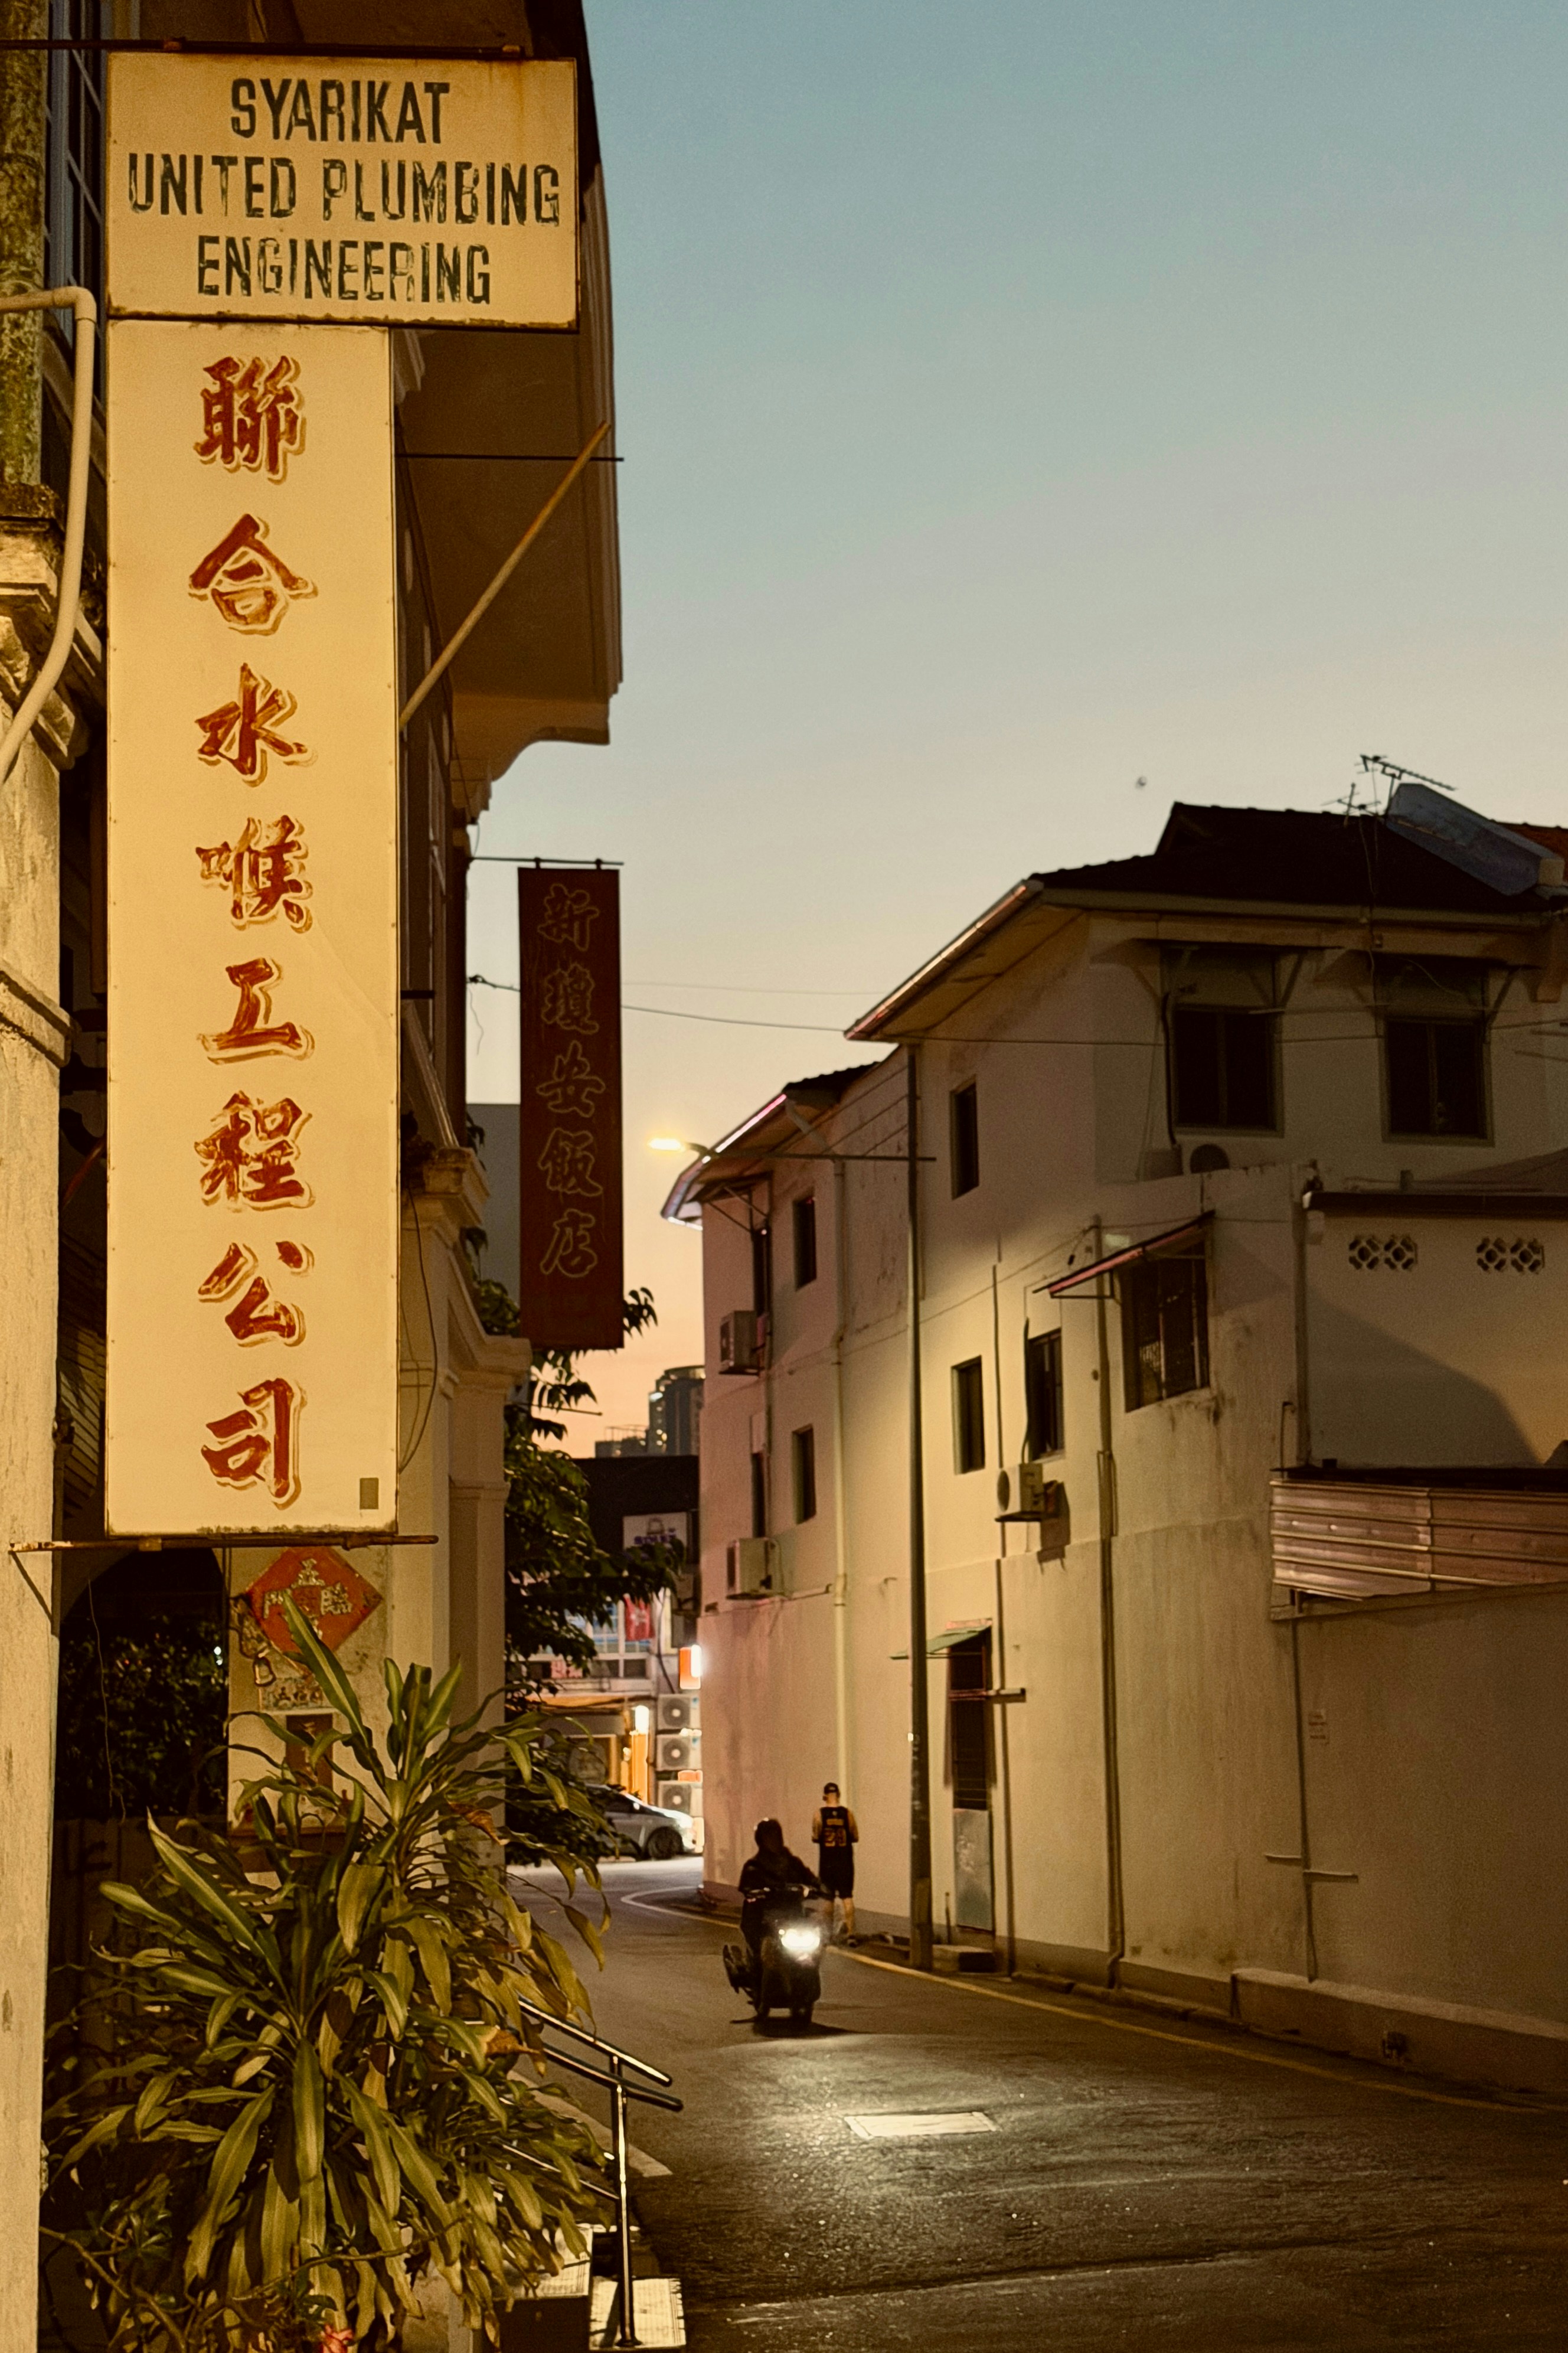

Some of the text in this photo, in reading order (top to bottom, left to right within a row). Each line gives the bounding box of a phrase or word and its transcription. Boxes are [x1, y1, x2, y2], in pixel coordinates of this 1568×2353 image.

[231, 77, 449, 143] SYARIKAT
[129, 152, 561, 227] UNITED PLUMBING
[197, 235, 491, 305] ENGINEERING
